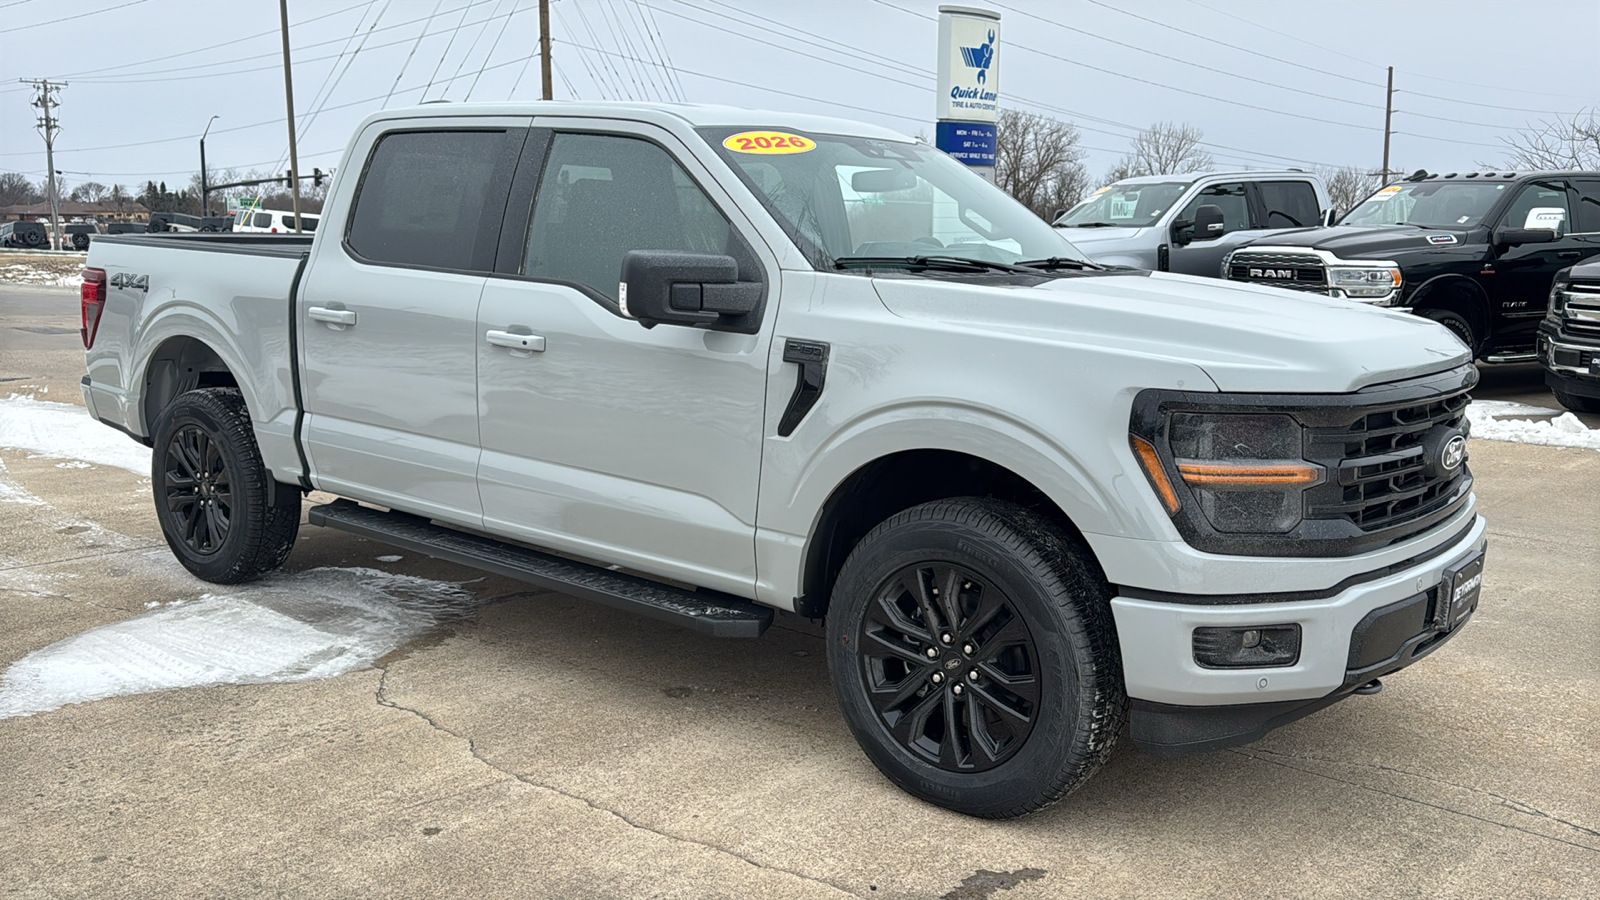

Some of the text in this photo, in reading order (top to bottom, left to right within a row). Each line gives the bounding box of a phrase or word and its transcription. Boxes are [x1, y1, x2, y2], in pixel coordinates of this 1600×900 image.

[950, 86, 997, 101] Quick Lane
[736, 136, 806, 150] 2026
[1250, 268, 1292, 279] RAM
